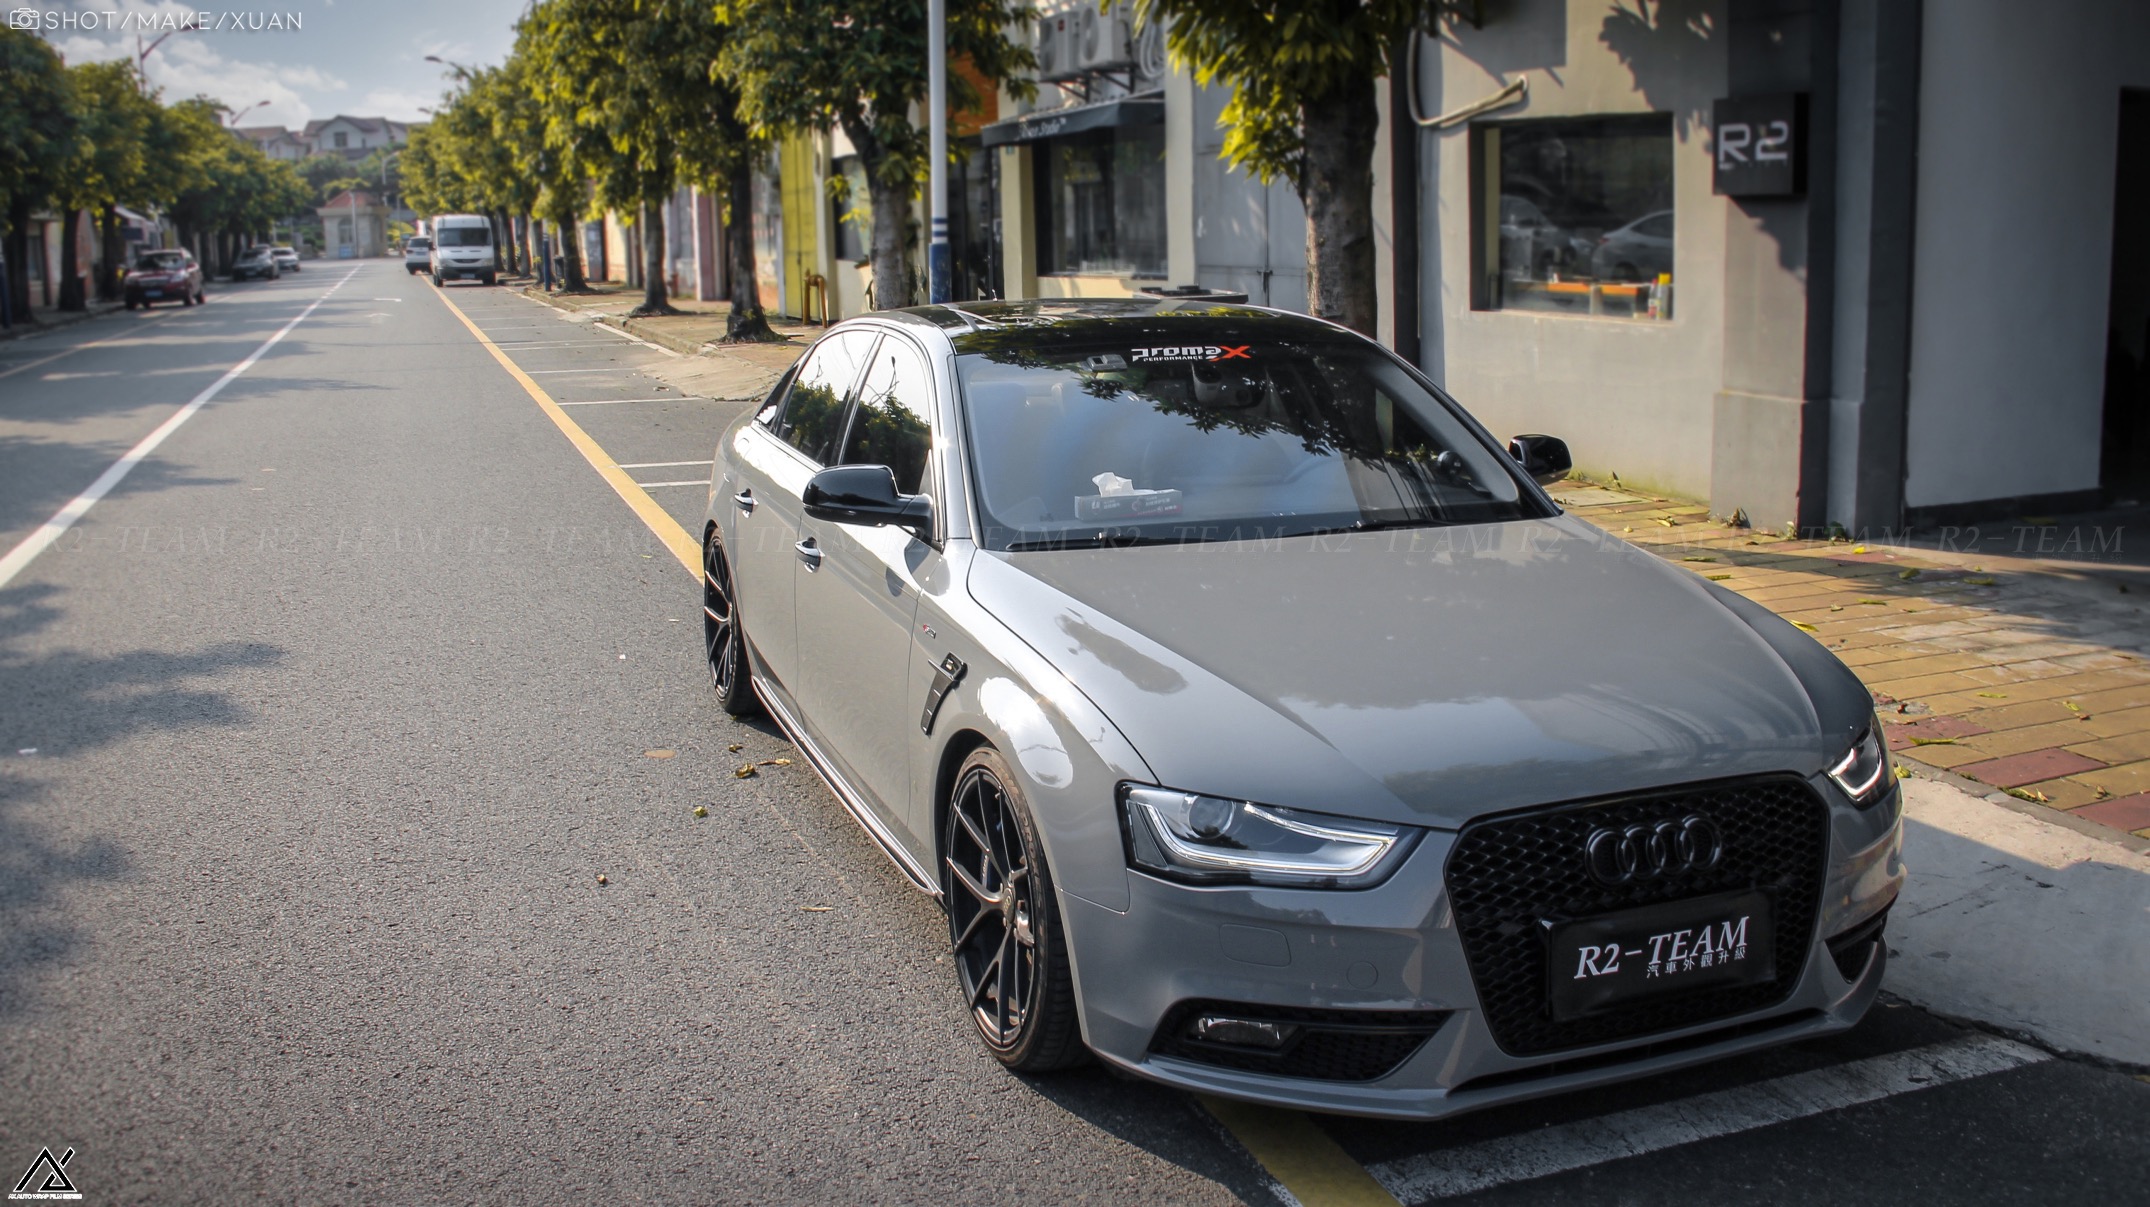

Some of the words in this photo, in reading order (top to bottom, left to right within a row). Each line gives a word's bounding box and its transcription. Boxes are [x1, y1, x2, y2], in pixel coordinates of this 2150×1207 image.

[1718, 121, 1788, 162] R2
[1573, 916, 1750, 980] R2-TEAM
[1646, 946, 1746, 979] 汽車外觀升級
